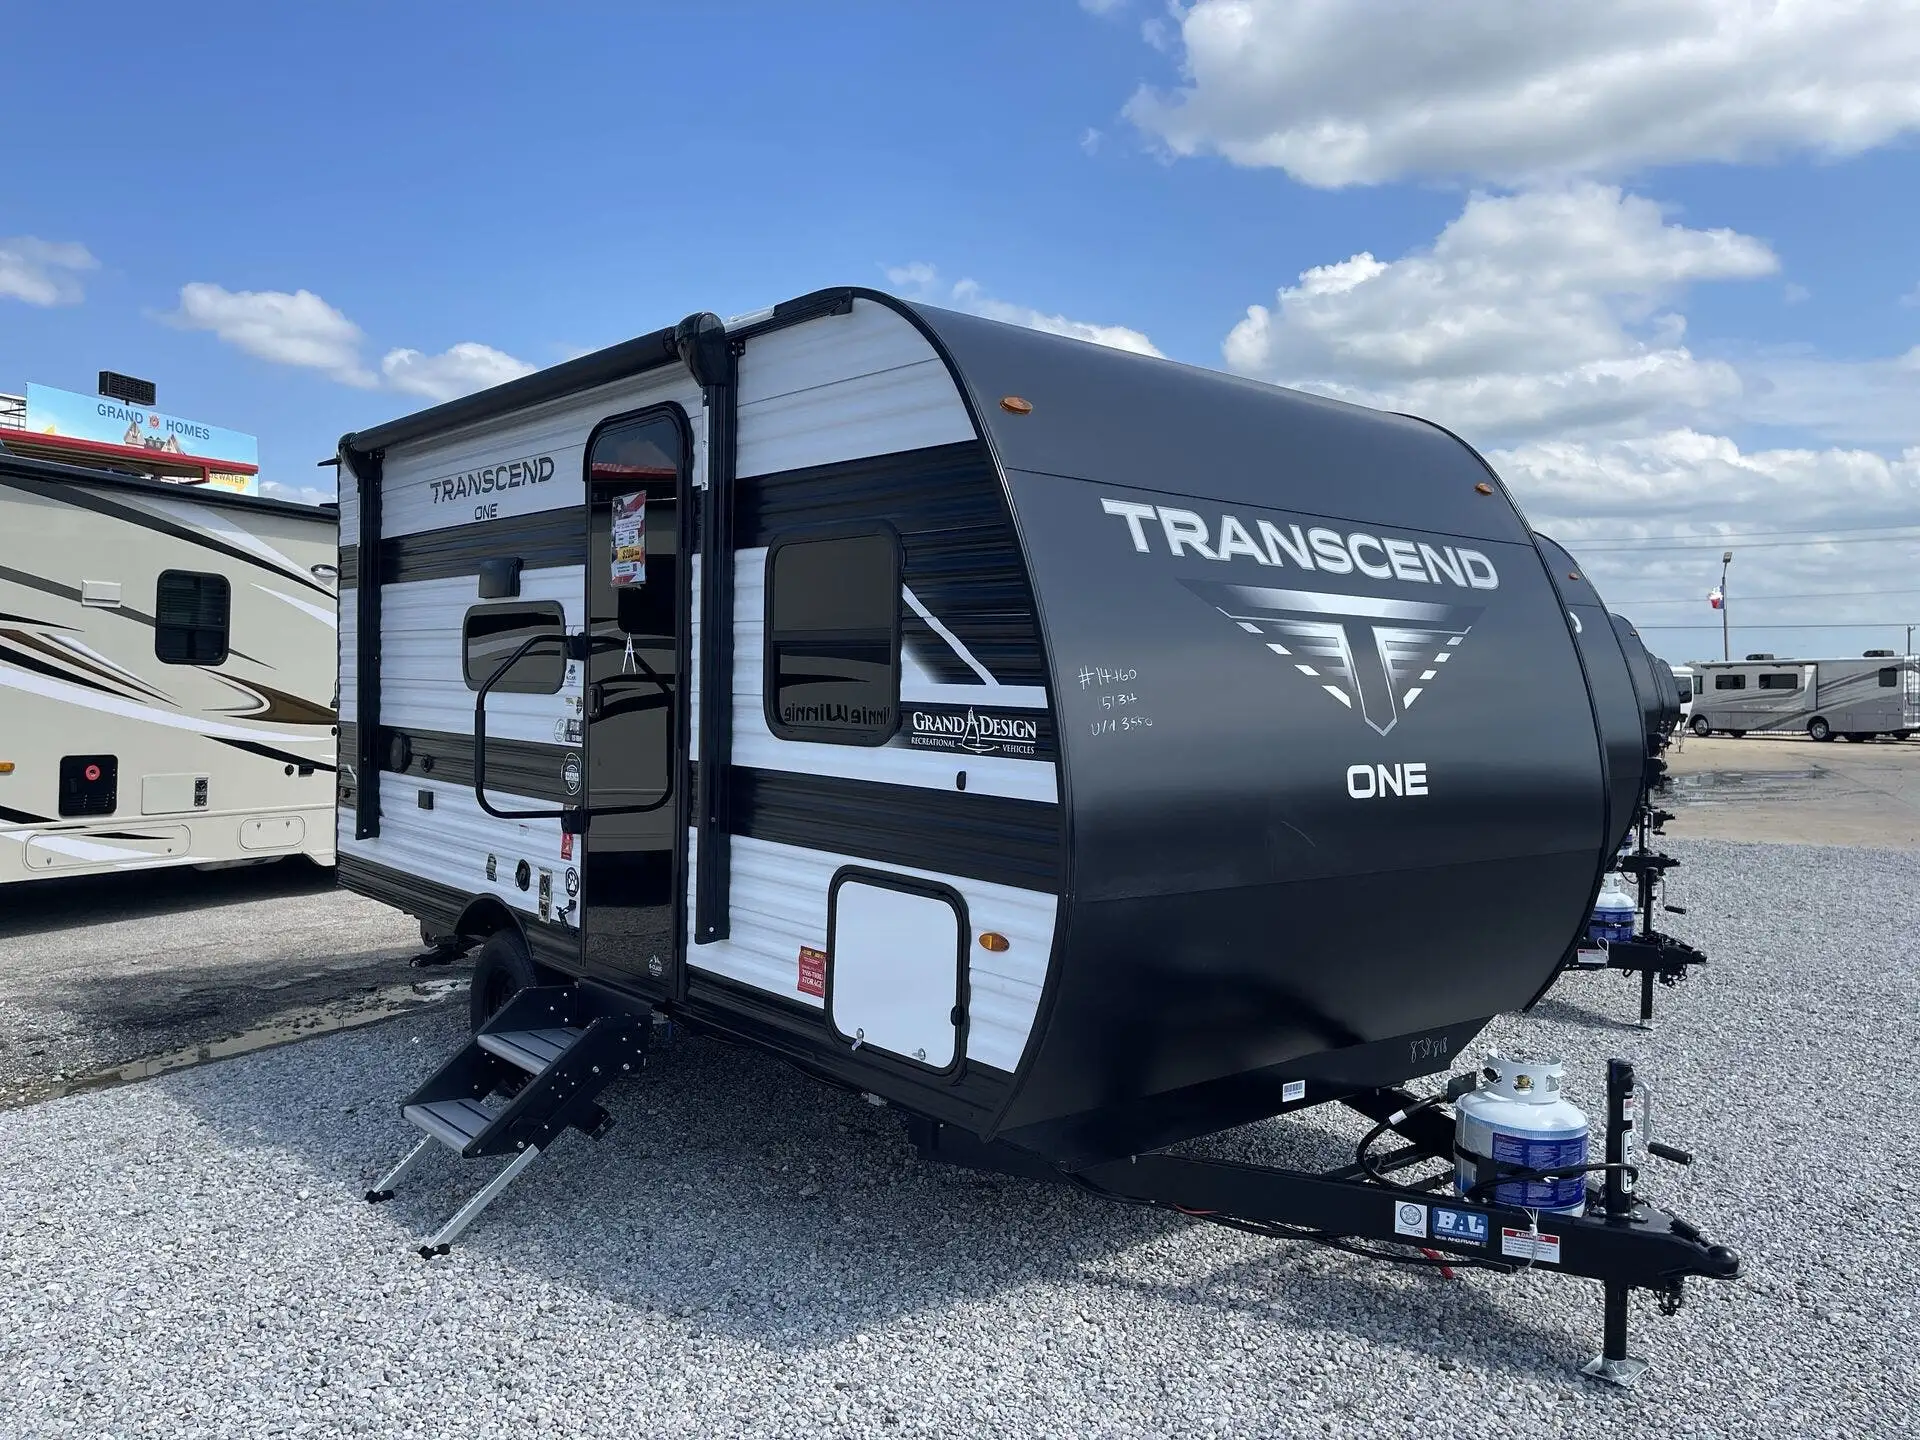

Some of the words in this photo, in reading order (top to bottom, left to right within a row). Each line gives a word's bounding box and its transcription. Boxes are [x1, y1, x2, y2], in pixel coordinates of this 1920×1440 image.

[97, 403, 144, 424] GRAND
[166, 419, 210, 440] HOMES
[429, 456, 555, 504] TRANSCEND
[474, 502, 499, 520] ONE
[1100, 497, 1500, 591] TRANSCEND
[912, 711, 965, 733] GRAND
[978, 715, 1037, 739] DESIGN
[911, 736, 956, 748] RECREATIONAL
[1002, 744, 1035, 755] VEHICLES
[1346, 762, 1429, 799] ONE
[1437, 1210, 1485, 1235] BAL
